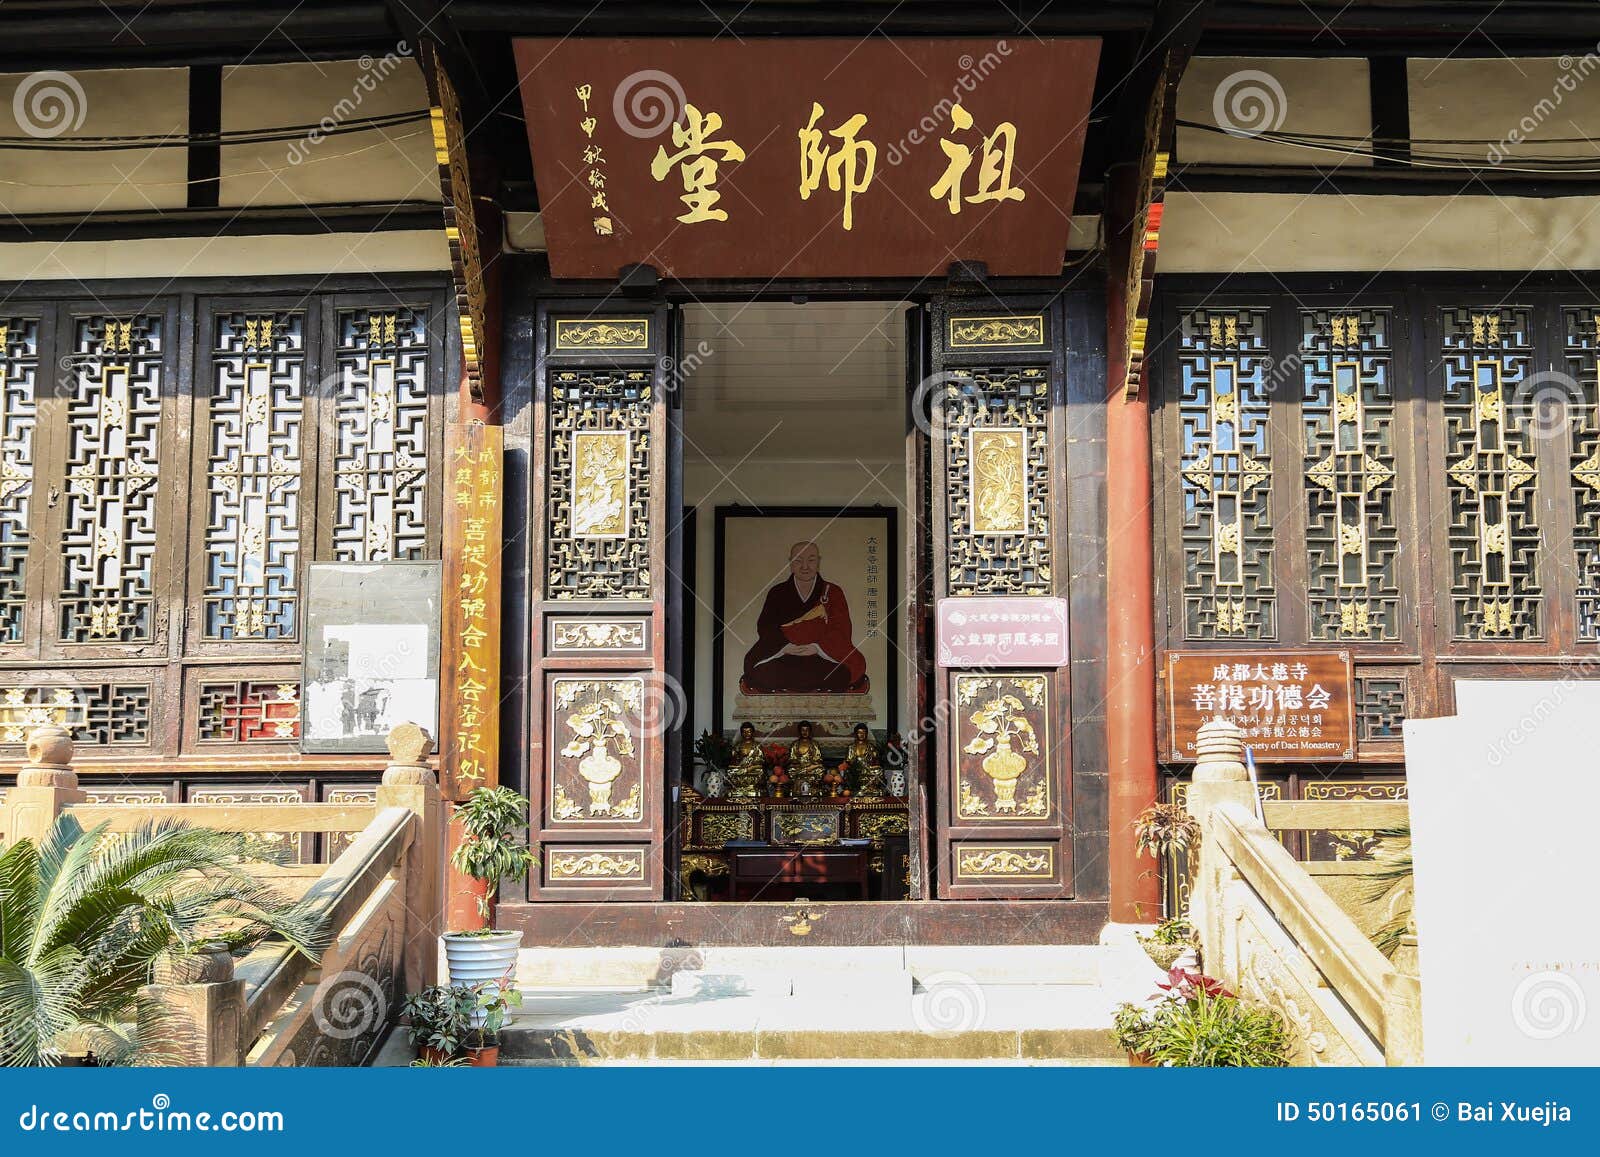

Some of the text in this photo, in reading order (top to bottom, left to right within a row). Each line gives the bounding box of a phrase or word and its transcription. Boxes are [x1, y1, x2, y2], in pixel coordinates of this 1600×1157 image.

[479, 447, 498, 510] 成都市
[1212, 662, 1309, 681] 成都大慈寺
[1190, 683, 1332, 711] 菩提功德会
[1241, 741, 1341, 751] Society of Daci Monastery
